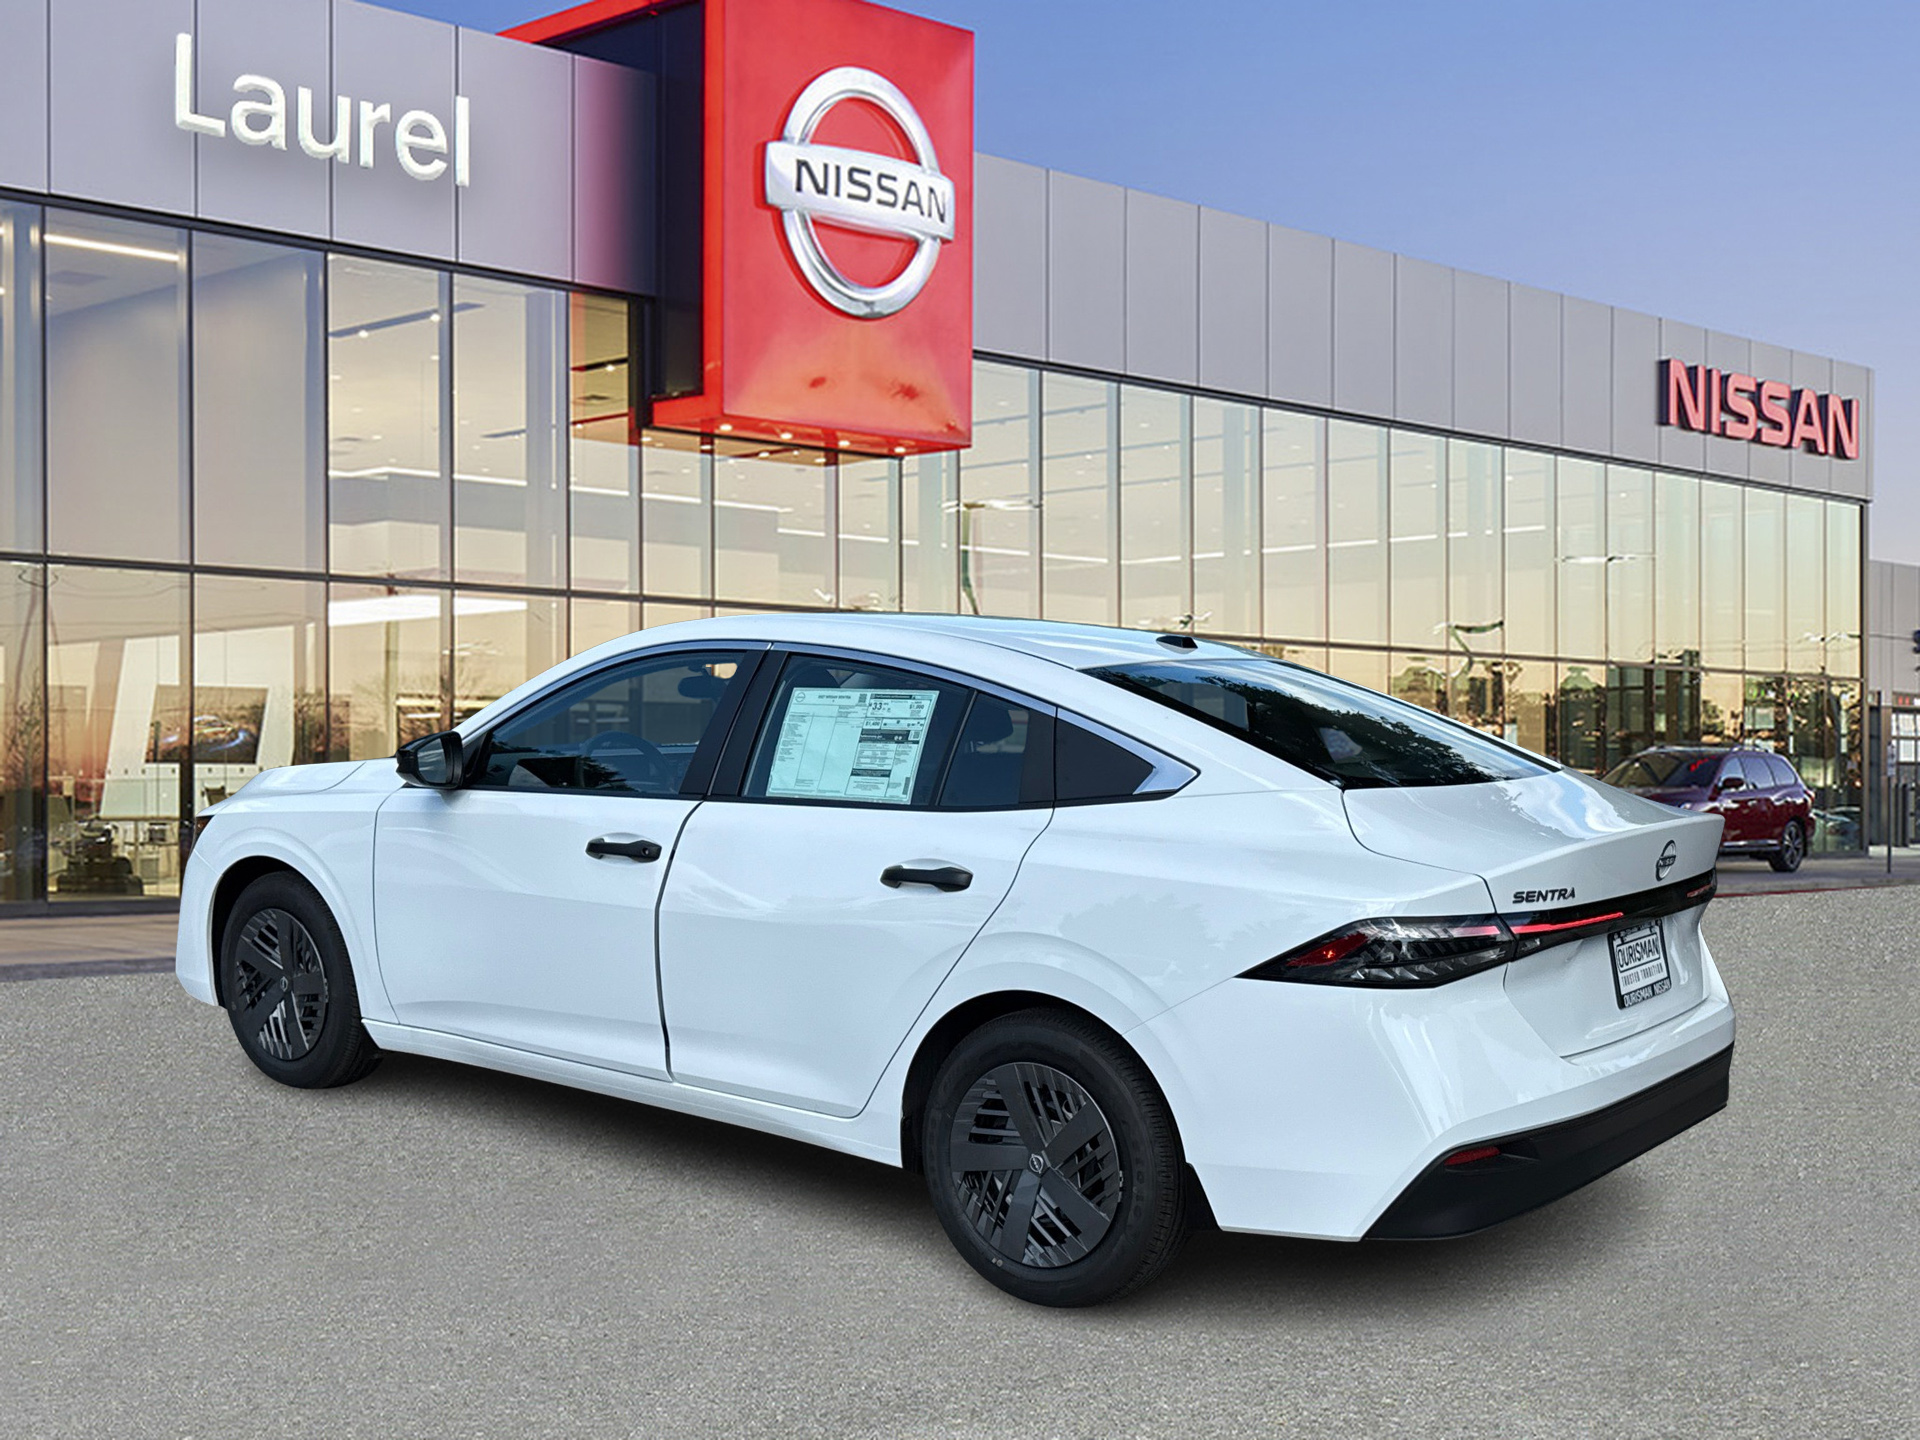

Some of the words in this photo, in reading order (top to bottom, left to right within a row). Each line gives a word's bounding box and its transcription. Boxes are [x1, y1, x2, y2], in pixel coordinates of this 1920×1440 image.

[175, 33, 470, 187] Laurel
[795, 158, 946, 223] NISSAN
[1657, 358, 1860, 460] NISSAN
[1512, 887, 1575, 904] SENTRA
[1618, 937, 1660, 968] OURISMAN
[1621, 971, 1640, 987] TRUSTED
[1640, 963, 1663, 979] TRADITION
[1623, 985, 1653, 1008] OURISMAN
[1653, 978, 1671, 995] NISSAN
